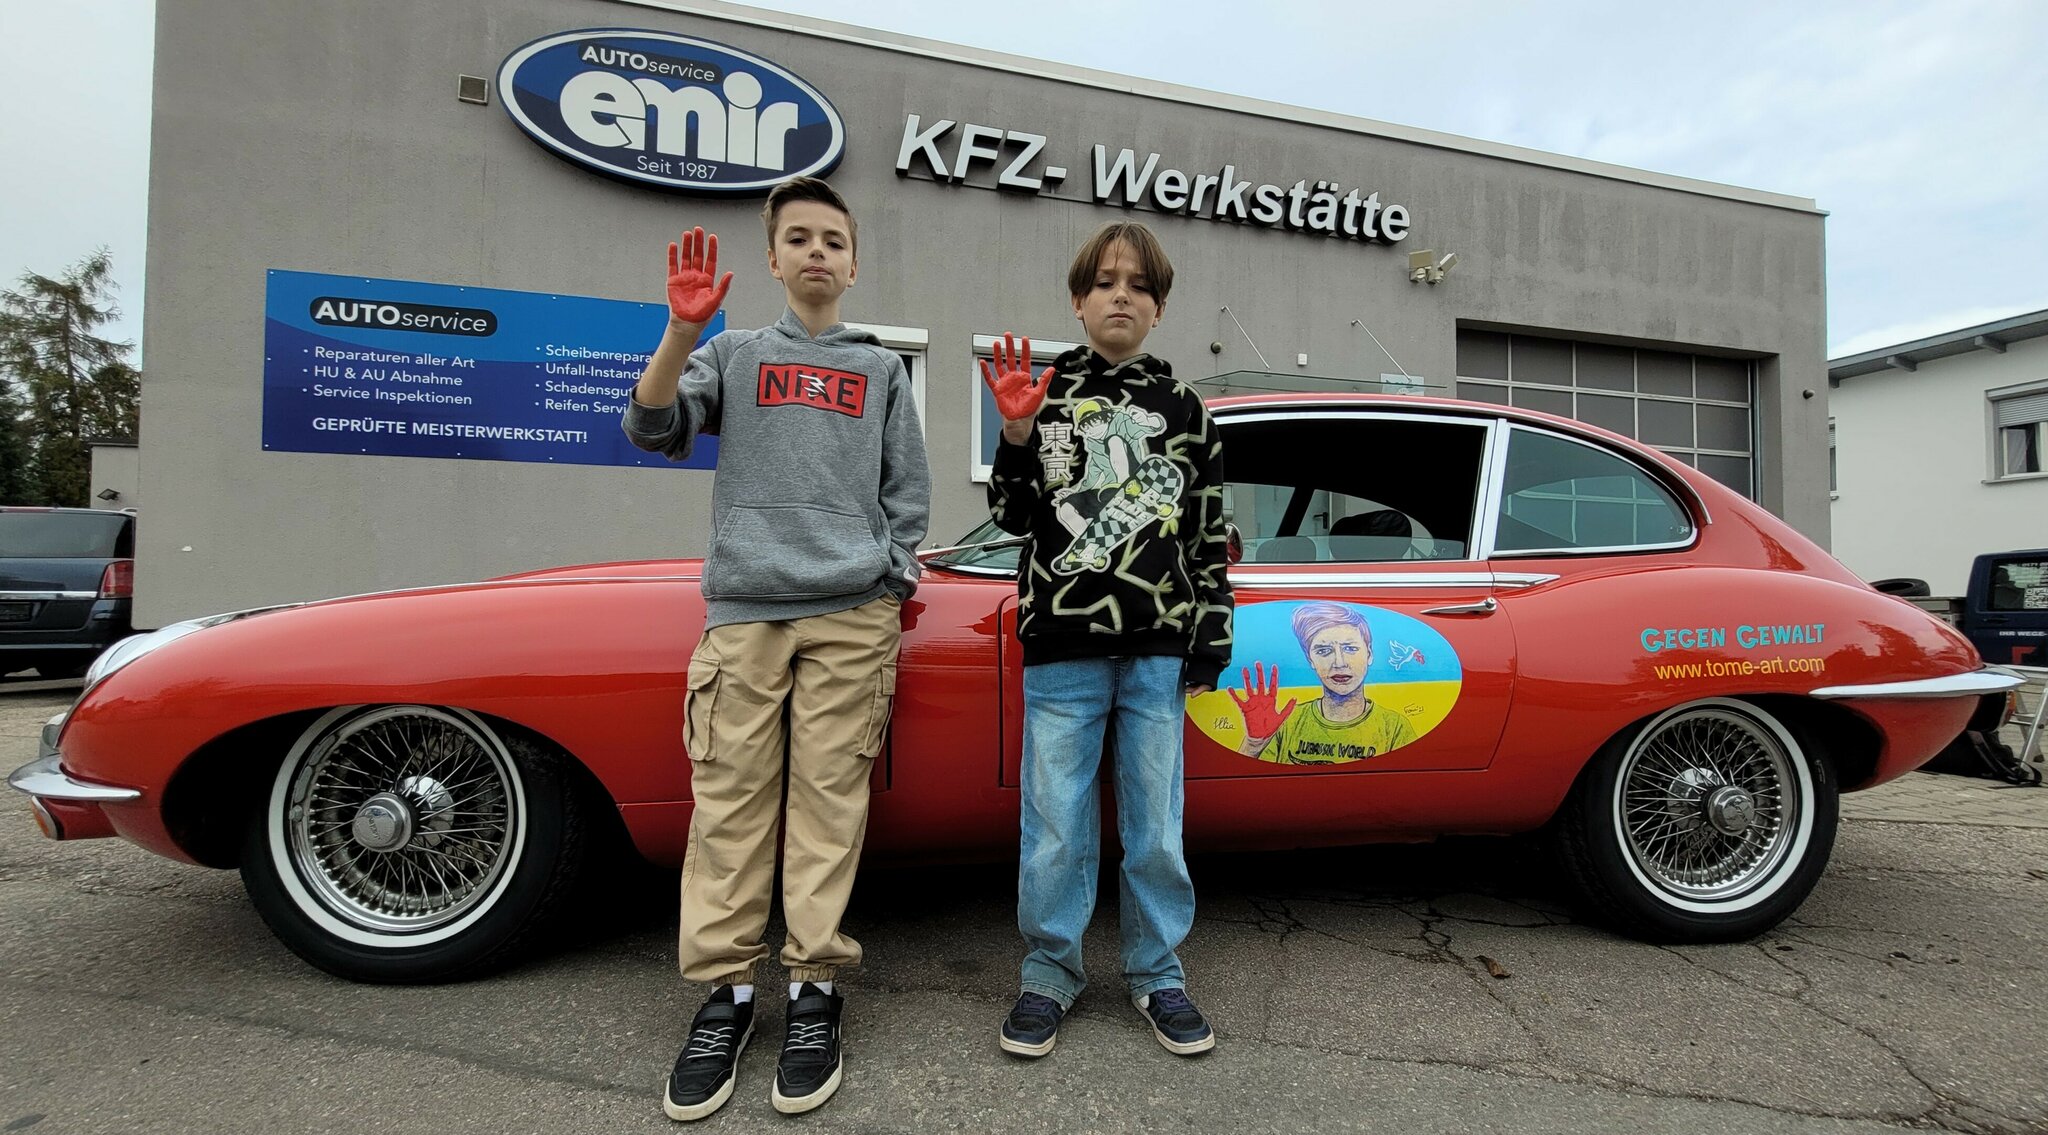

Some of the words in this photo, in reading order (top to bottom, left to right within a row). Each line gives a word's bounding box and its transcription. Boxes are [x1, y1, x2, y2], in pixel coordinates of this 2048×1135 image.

[582, 45, 715, 82] AUTOservice
[560, 71, 798, 171] emir
[637, 156, 671, 175] Seit
[679, 161, 717, 180] 1987
[896, 113, 1067, 191] KFZ-
[1091, 143, 1411, 244] Werkstätte
[315, 300, 488, 332] AUTOservice
[315, 346, 410, 364] Reparaturen
[415, 353, 447, 366] aller
[451, 356, 475, 368] Art
[314, 366, 339, 378] HU
[344, 367, 356, 380] &
[361, 369, 385, 381] AU
[390, 371, 463, 386] Abnahme
[313, 385, 370, 399] Service
[375, 388, 472, 405] Inspektionen
[765, 370, 859, 410] NIKE
[545, 399, 588, 413] Reifen
[312, 417, 407, 434] GEPRÜFTE
[412, 423, 588, 443] MEISTERWERKSTATT!
[1039, 422, 1074, 481] 東京
[1640, 627, 1726, 652] GEGEN
[1736, 624, 1825, 649] GEWALT
[1654, 656, 1825, 680] www.tome-art.com
